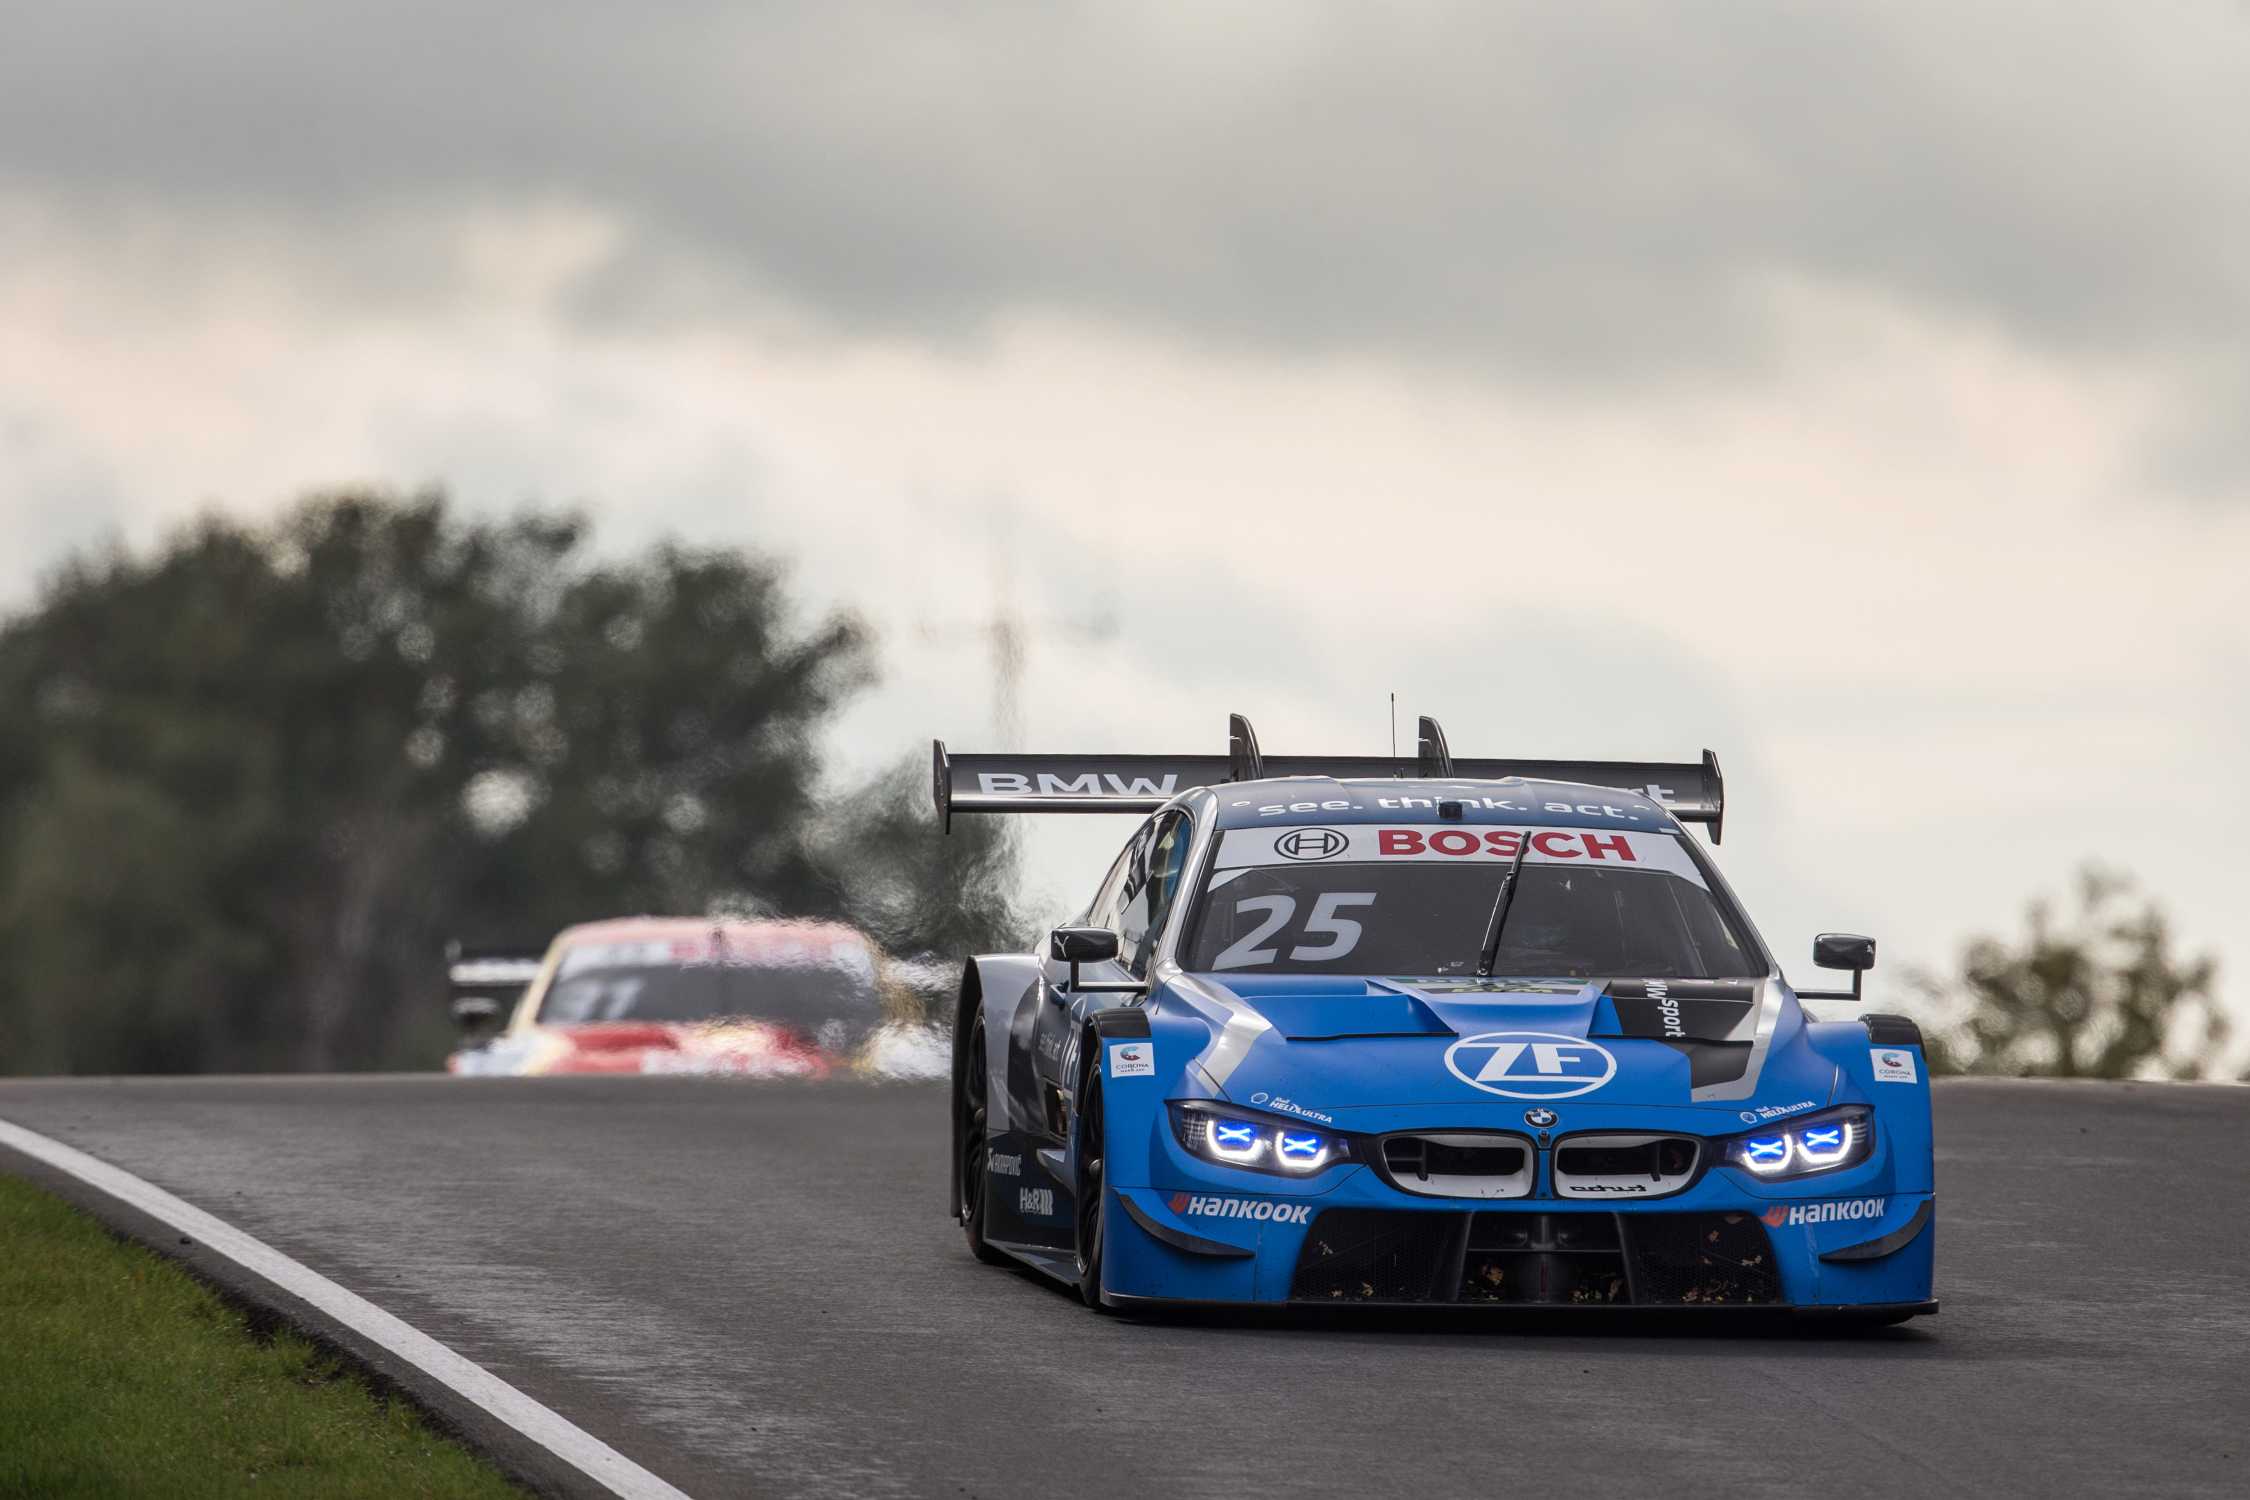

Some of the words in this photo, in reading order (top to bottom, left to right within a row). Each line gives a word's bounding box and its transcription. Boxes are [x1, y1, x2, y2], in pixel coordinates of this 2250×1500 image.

[977, 773, 1178, 796] BMW
[1258, 800, 1364, 816] see.
[1543, 801, 1639, 821] act.
[1378, 830, 1637, 862] BOSCH
[1211, 892, 1377, 971] 25
[1450, 1042, 1606, 1083] ZF
[1269, 1100, 1302, 1114] HELIX
[1302, 1109, 1333, 1123] ULTRA
